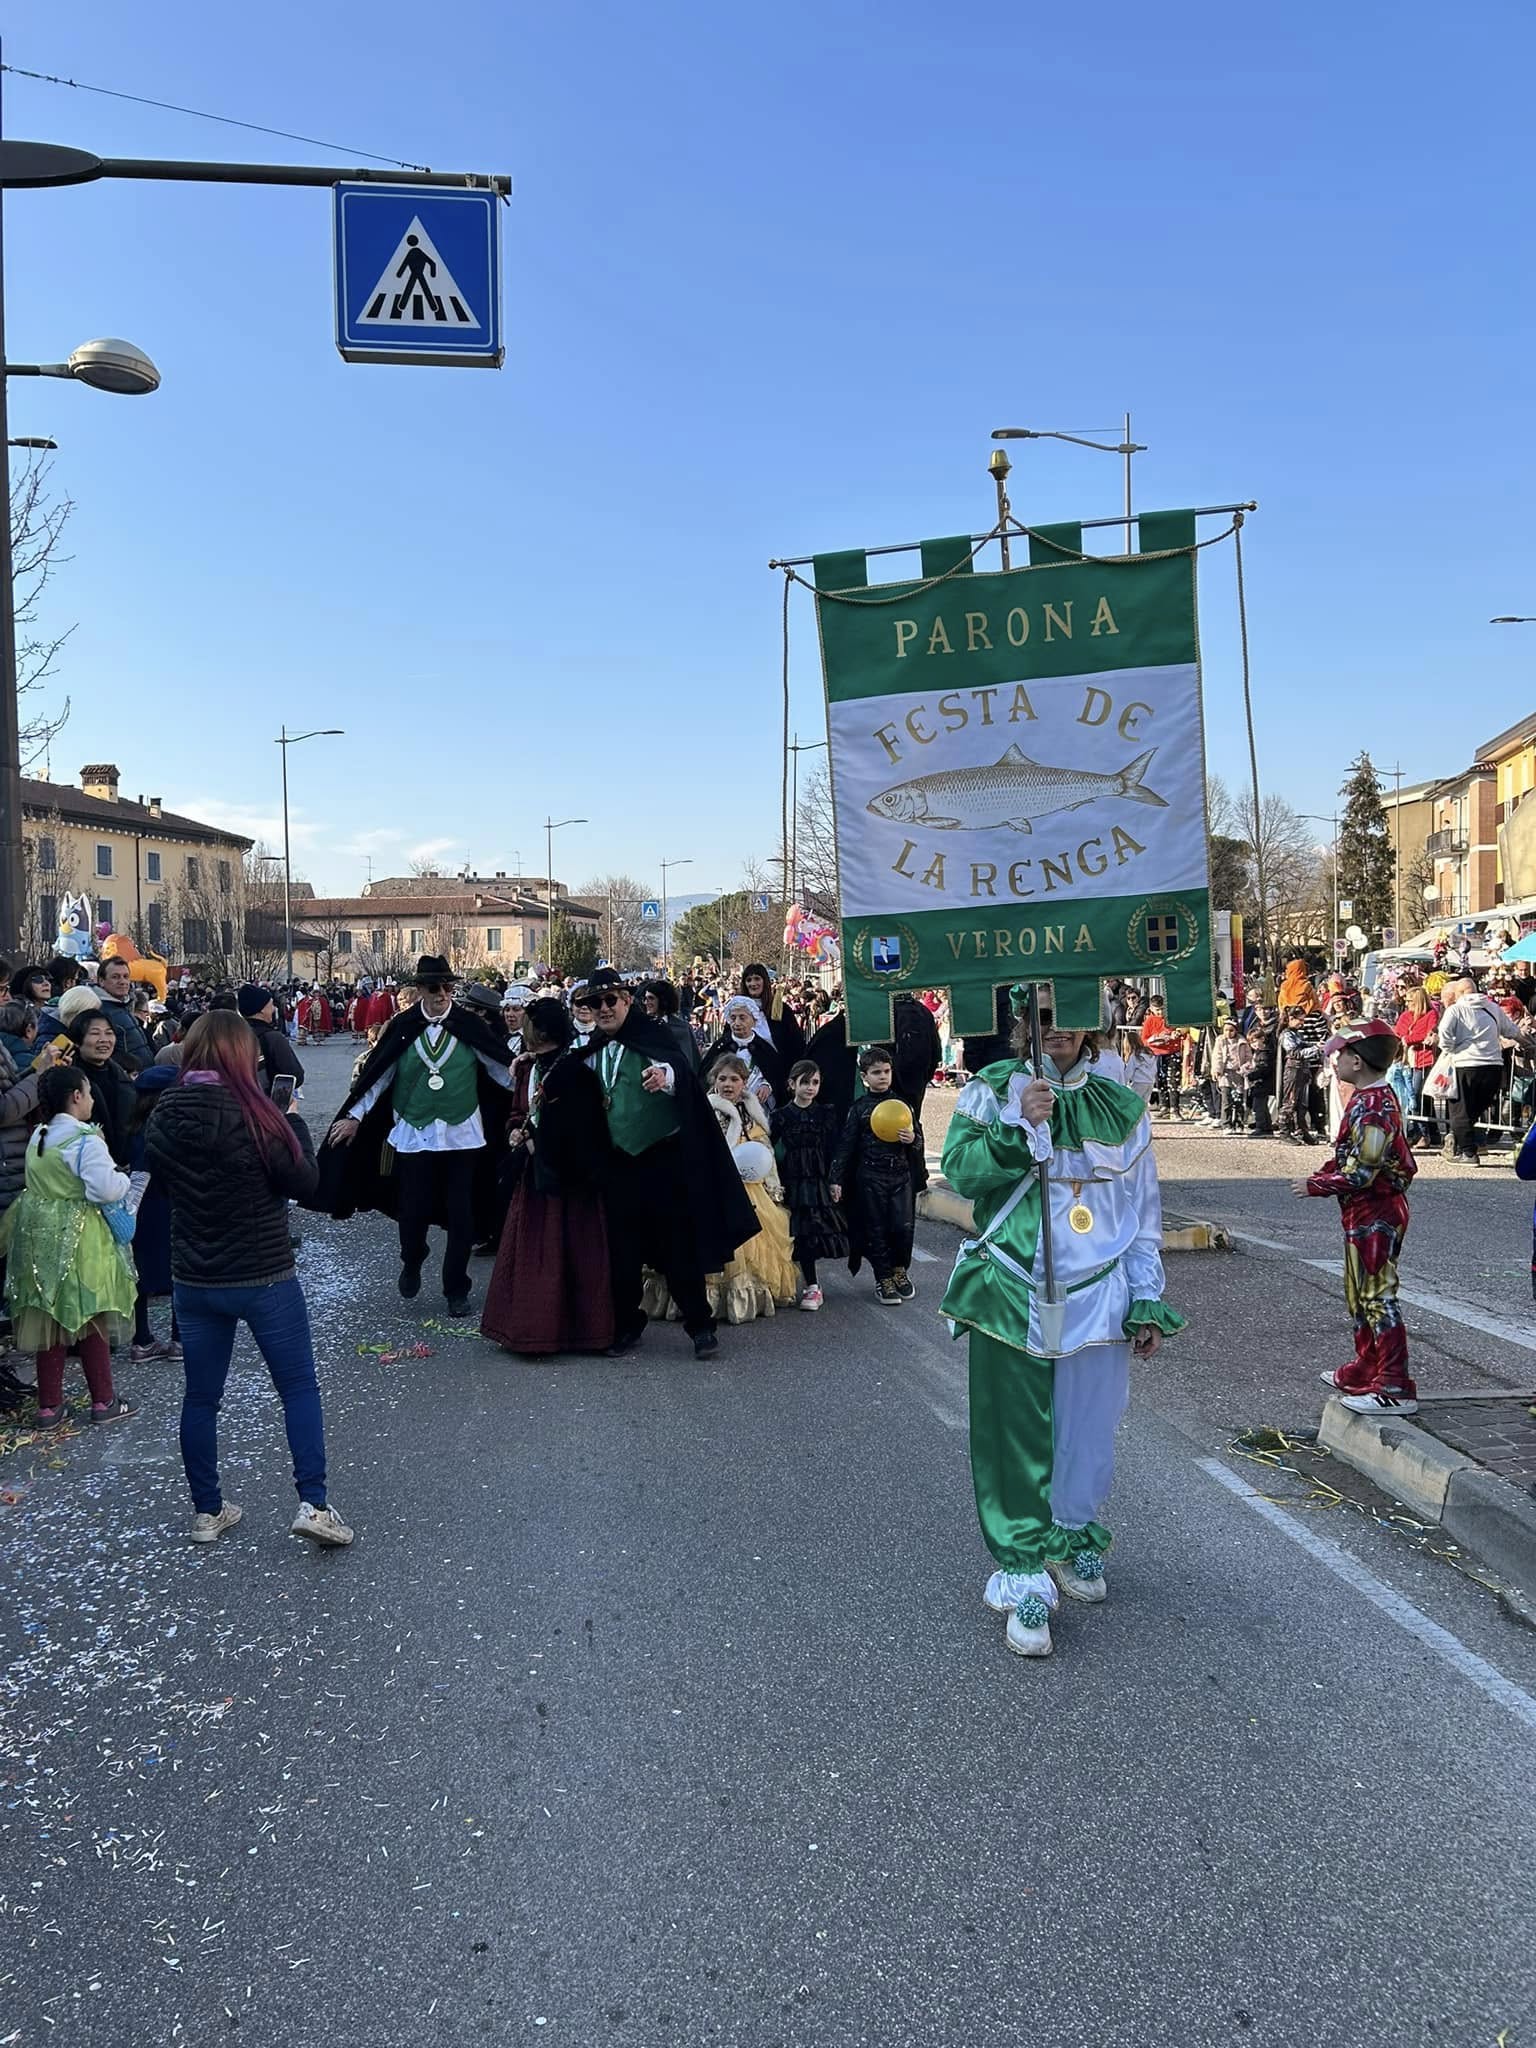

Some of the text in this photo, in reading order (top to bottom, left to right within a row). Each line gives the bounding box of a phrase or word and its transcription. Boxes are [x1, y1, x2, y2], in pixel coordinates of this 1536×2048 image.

[893, 596, 1120, 658] PARONA
[872, 684, 1155, 766] FESTA DE
[891, 825, 1147, 897] LA RENGA
[945, 924, 1097, 960] VERONA
